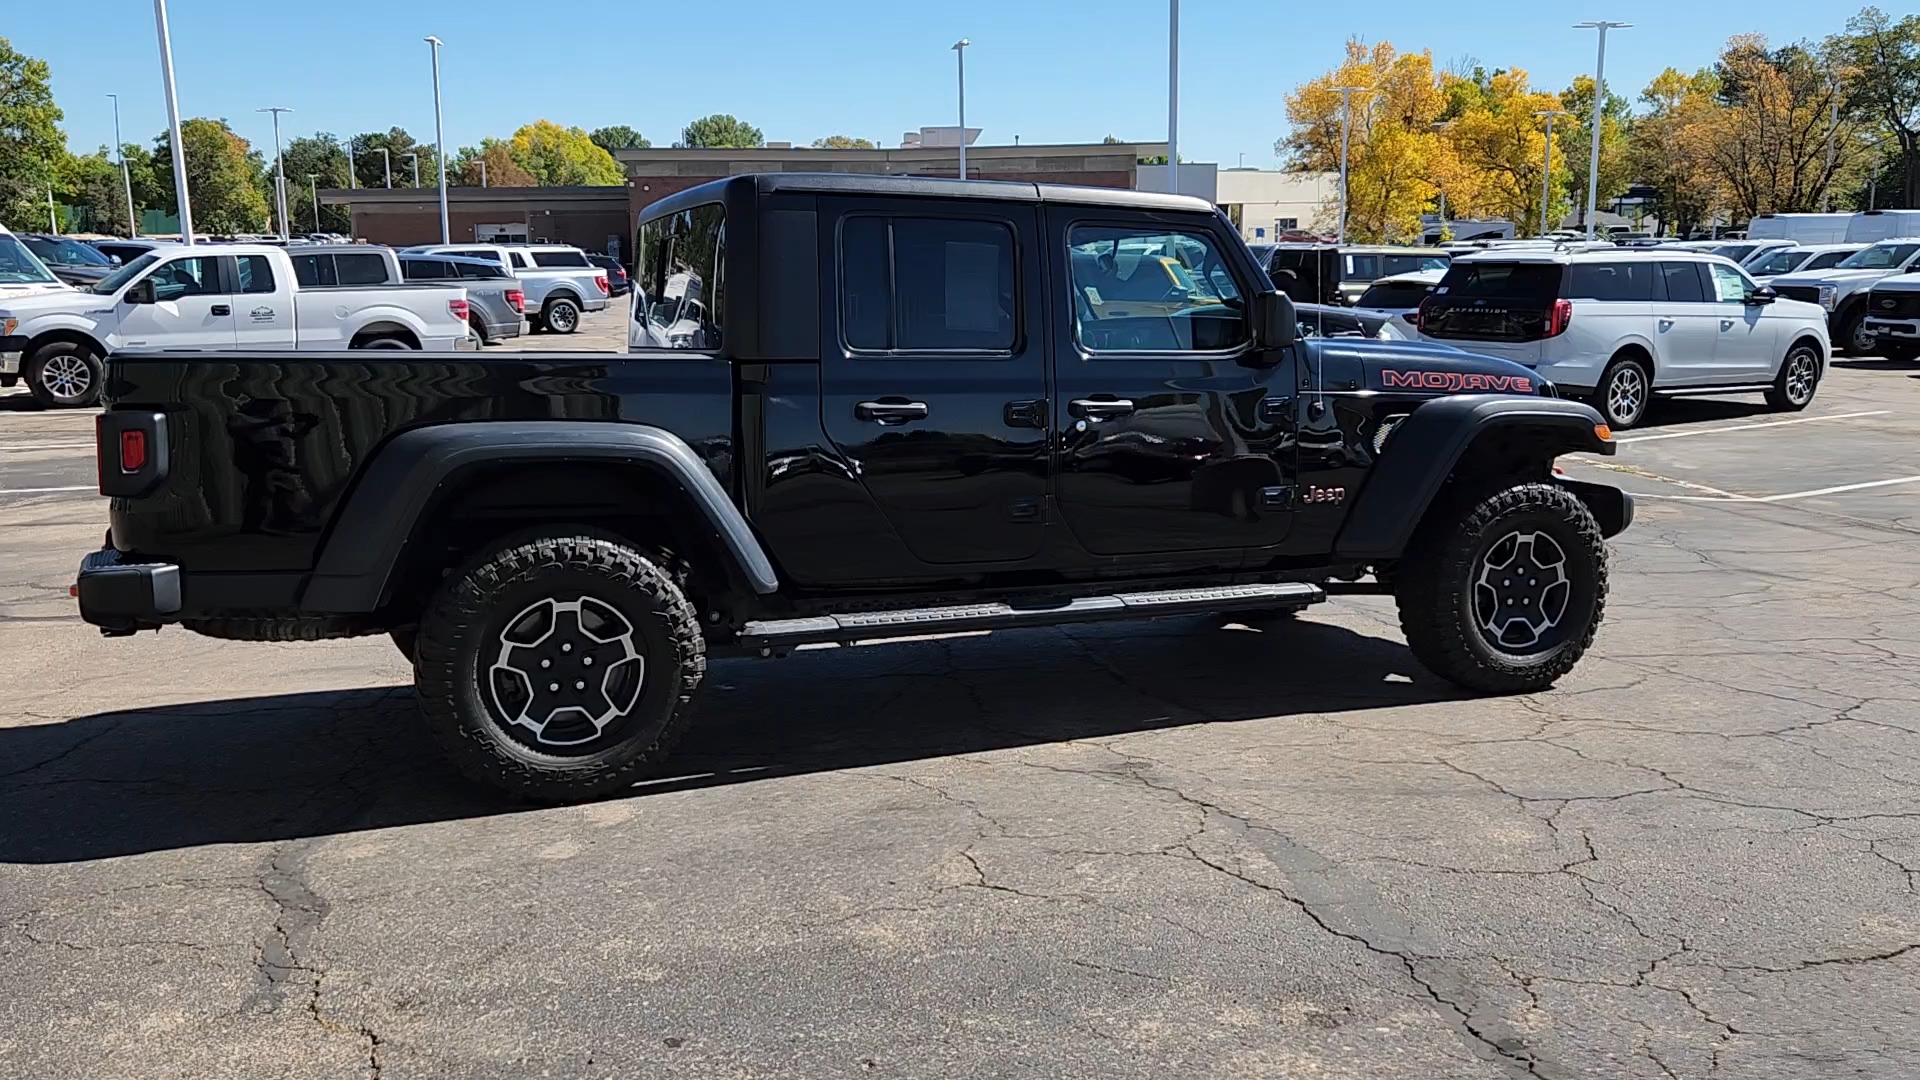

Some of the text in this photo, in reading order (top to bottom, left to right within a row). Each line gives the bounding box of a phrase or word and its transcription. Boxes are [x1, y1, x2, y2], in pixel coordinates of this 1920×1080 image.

[1449, 307, 1508, 315] EXPEDITION
[1382, 369, 1533, 393] MOJAVE
[1302, 484, 1346, 506] Jeep
